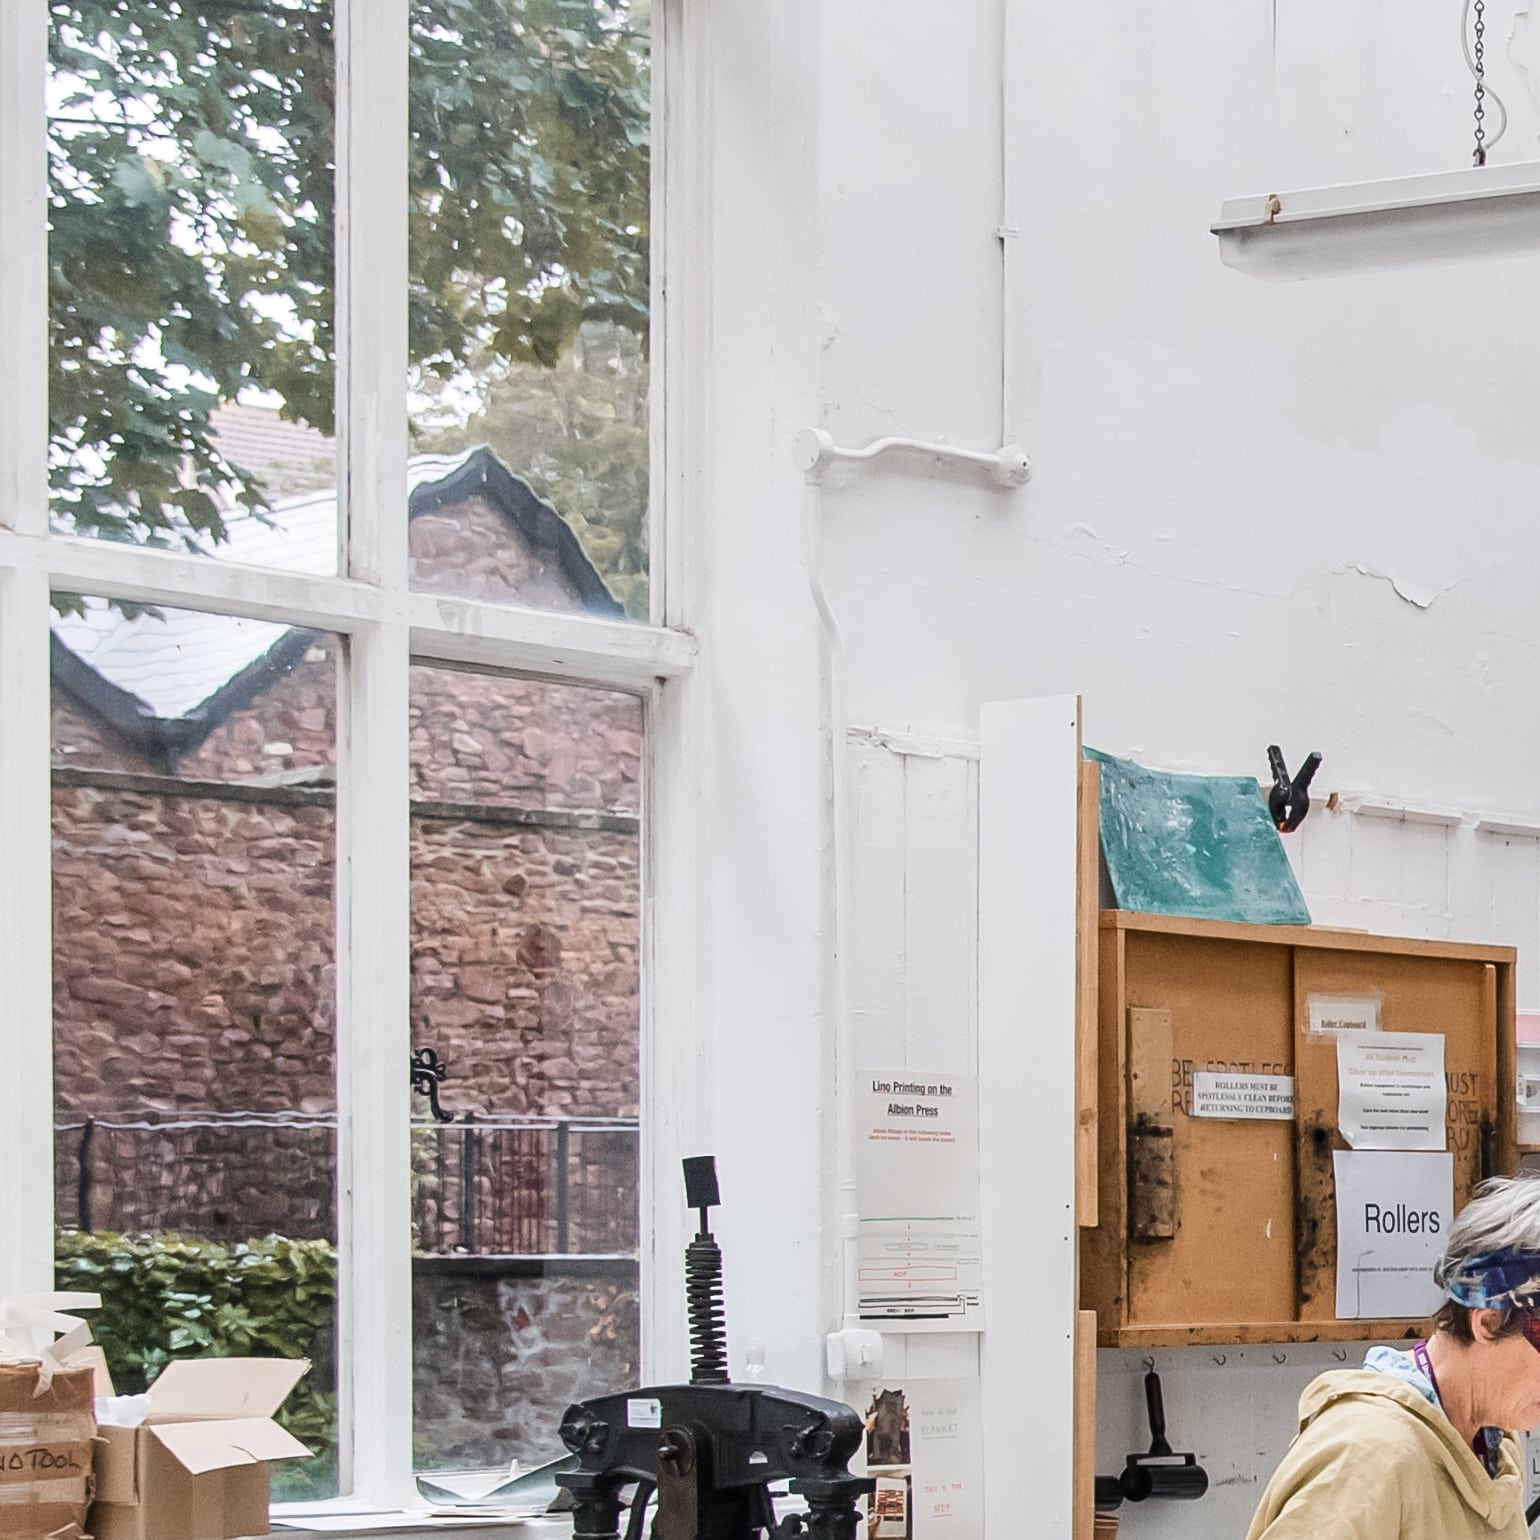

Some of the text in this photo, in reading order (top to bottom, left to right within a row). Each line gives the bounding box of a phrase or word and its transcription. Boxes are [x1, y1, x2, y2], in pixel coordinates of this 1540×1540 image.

[872, 1080, 952, 1095] Lino Printing on the
[1215, 1081, 1249, 1090] ROLLERS
[1250, 1082, 1268, 1090] MUST
[1446, 1071, 1478, 1096] UST
[1198, 1091, 1242, 1101] SPOTLESSLY
[1244, 1093, 1267, 1102] CLEAN
[887, 1103, 938, 1116] Albion Press
[1200, 1103, 1292, 1114] RETURNING TO CUPBOARD
[1448, 1100, 1478, 1125] ORE
[1365, 1203, 1440, 1233] Rollers
